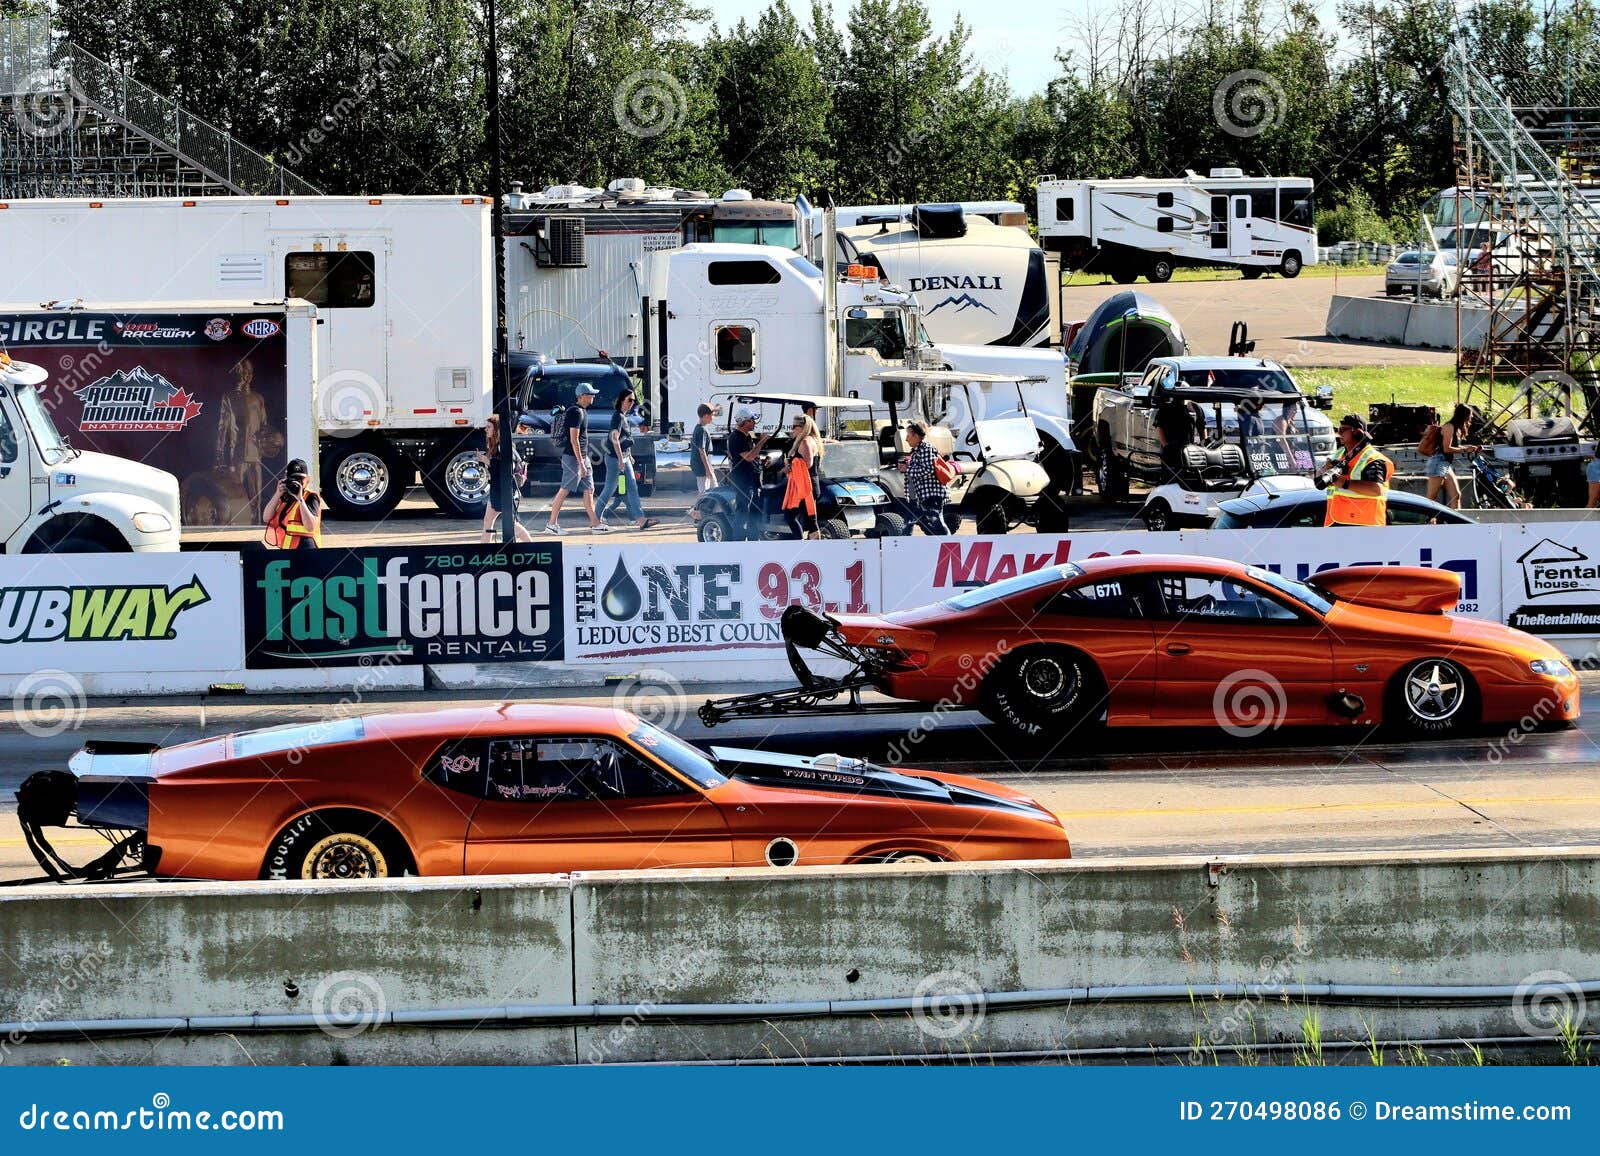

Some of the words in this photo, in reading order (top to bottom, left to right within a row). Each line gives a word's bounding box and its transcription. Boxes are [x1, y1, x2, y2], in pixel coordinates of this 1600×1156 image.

[909, 275, 1002, 292] DENALI
[122, 330, 196, 338] RACEWAY
[247, 322, 278, 335] NHRA
[88, 386, 152, 405] ROCKY
[424, 555, 464, 568] 780
[468, 553, 507, 566] 448
[512, 552, 553, 565] 0715
[576, 566, 596, 623] THE
[757, 560, 868, 620] 93.1
[1096, 581, 1122, 598] 6711
[1534, 580, 1579, 589] house
[257, 556, 551, 641] fastfence
[0, 575, 211, 643] UBWAY
[1454, 603, 1479, 613] 1982
[666, 623, 716, 644] BEST
[719, 622, 782, 642] COUN
[427, 640, 547, 656] RENTALS
[783, 768, 816, 779] TWIN
[819, 772, 865, 785] TURBO
